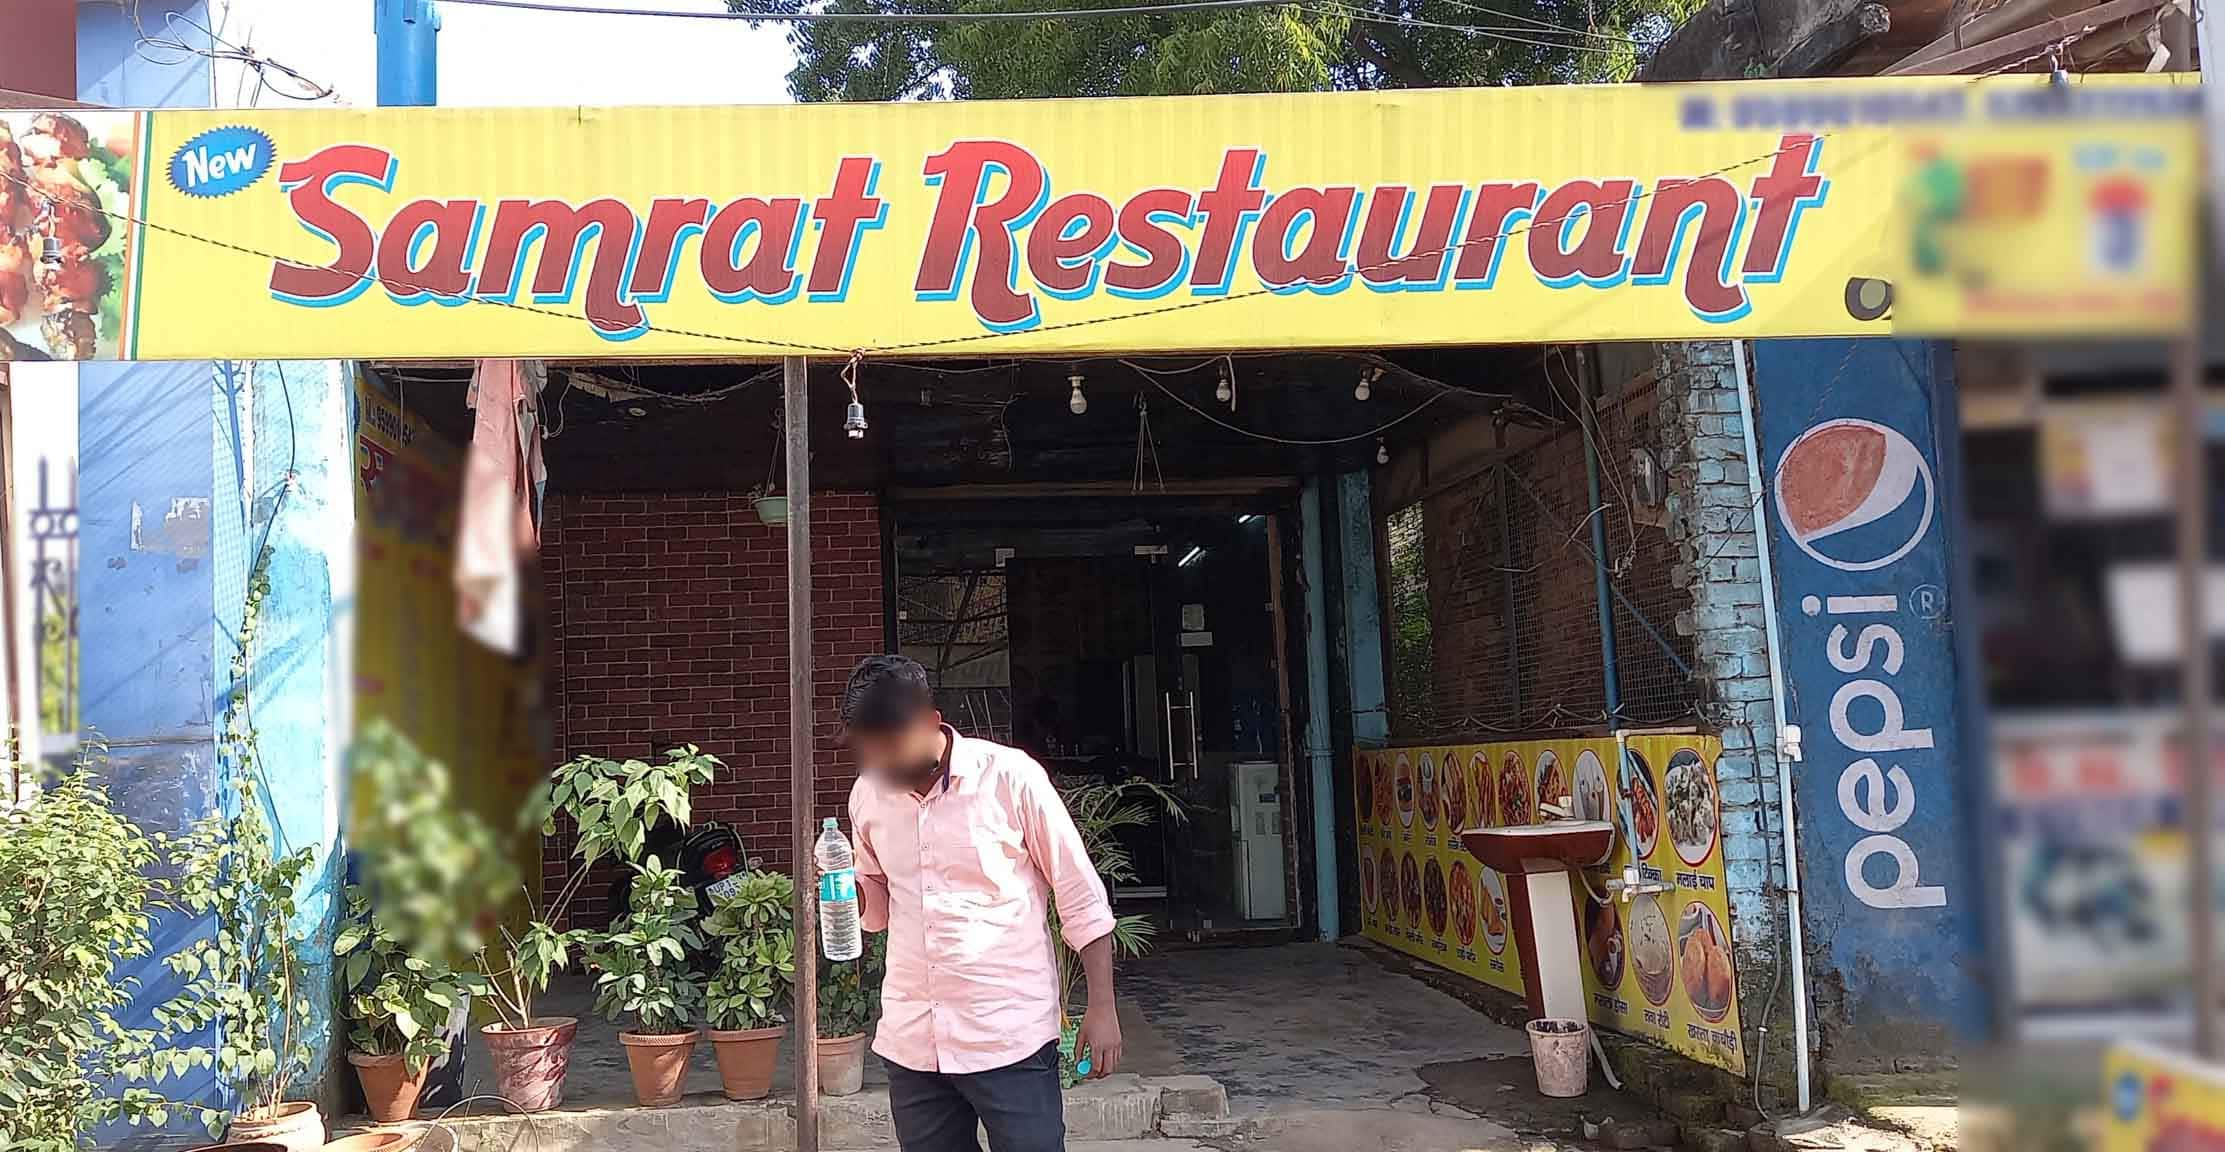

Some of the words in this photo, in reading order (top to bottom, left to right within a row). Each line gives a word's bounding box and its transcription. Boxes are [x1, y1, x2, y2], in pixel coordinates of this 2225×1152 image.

[185, 140, 257, 189] New
[270, 143, 888, 340] Samrat
[914, 132, 1830, 334] Restaurant
[1801, 595, 1947, 908] pepsi
